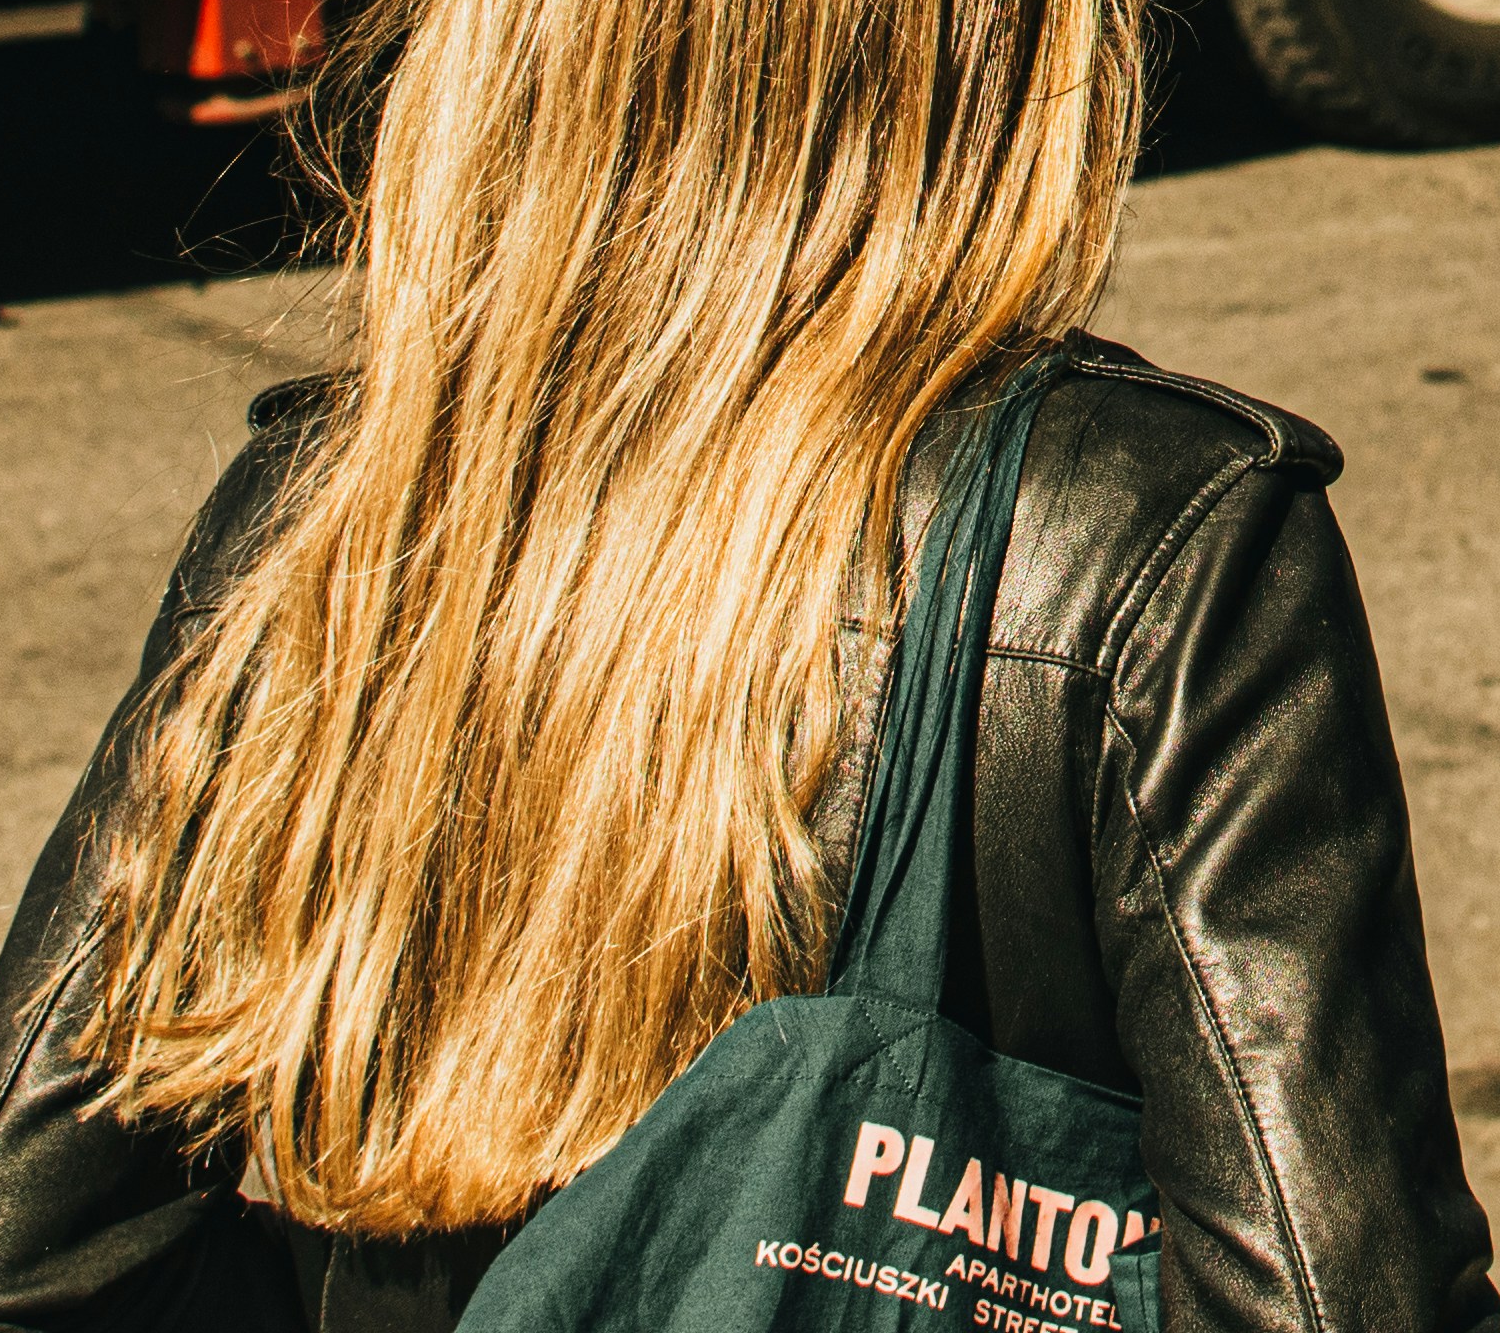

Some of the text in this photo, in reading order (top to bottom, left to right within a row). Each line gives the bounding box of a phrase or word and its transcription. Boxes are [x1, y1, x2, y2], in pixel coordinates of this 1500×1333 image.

[755, 1239, 950, 1310] KOŚCIUSZKI
[945, 1253, 1122, 1331] APARTHOTEL
[974, 1298, 1079, 1333] STRE
